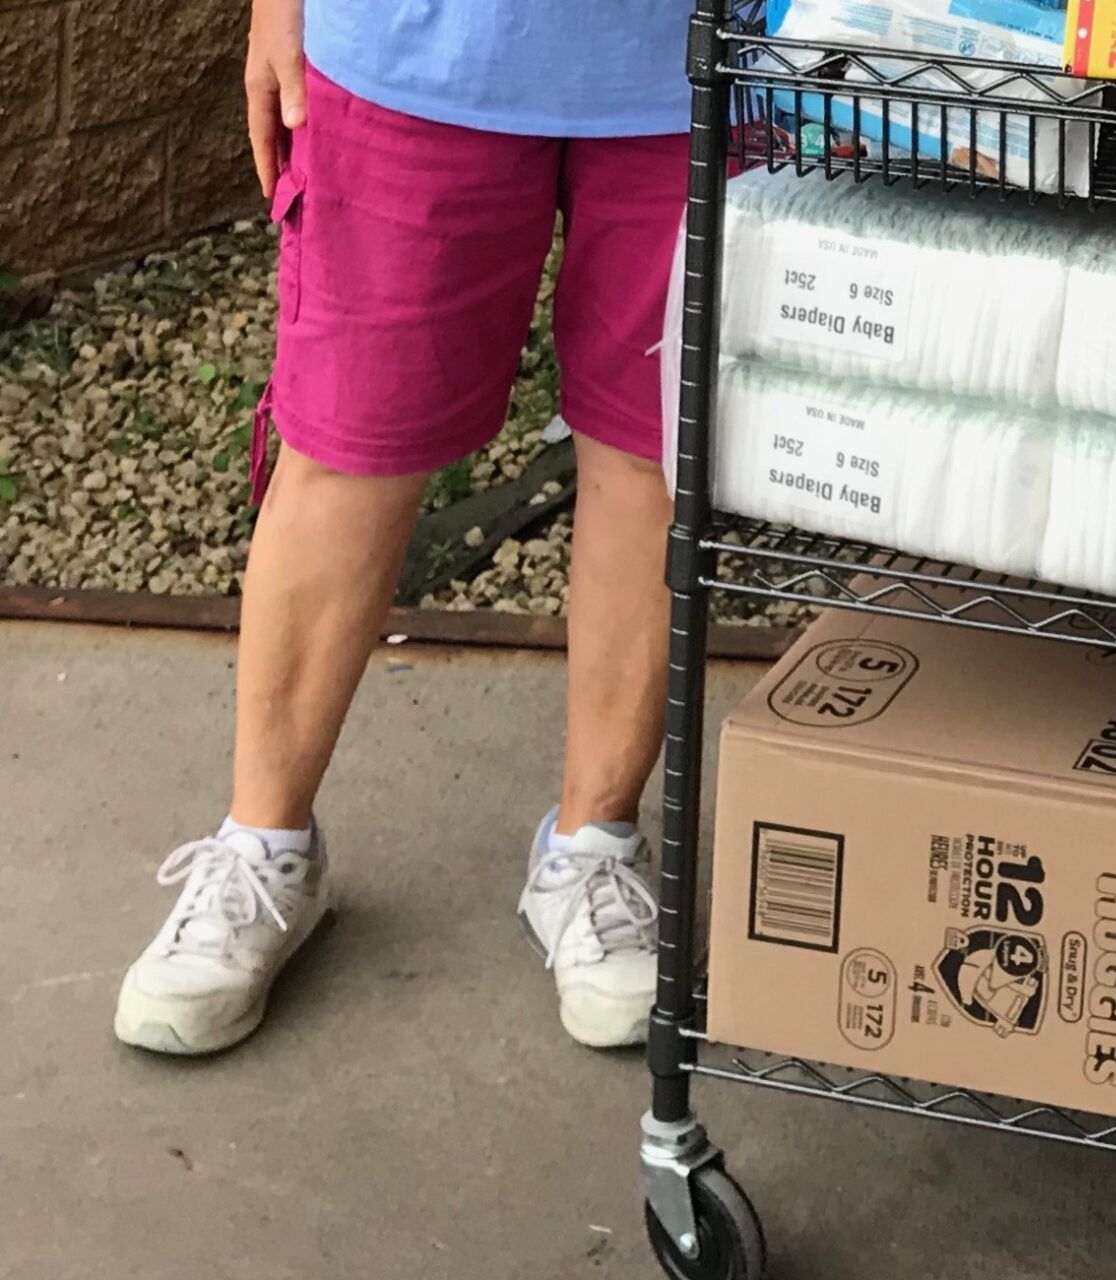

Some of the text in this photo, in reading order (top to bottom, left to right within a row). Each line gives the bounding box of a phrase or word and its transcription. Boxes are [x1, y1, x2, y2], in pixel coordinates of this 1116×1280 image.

[785, 269, 894, 306] Size 6 25ct
[781, 303, 895, 344] Baby Diapers
[806, 406, 825, 420] USA
[840, 416, 865, 430] MADE
[773, 434, 880, 477] Size 6 25ct
[769, 468, 881, 514] Baby Diapers
[859, 656, 900, 675] 5
[817, 685, 873, 719] 172
[961, 834, 975, 918] PROTECTION
[974, 836, 995, 920] HOUR
[995, 855, 1046, 927] 12
[1010, 944, 1034, 966] 4
[1062, 939, 1081, 1011] Snug & Dry
[864, 968, 887, 1039] 5 172
[908, 981, 935, 994] 4
